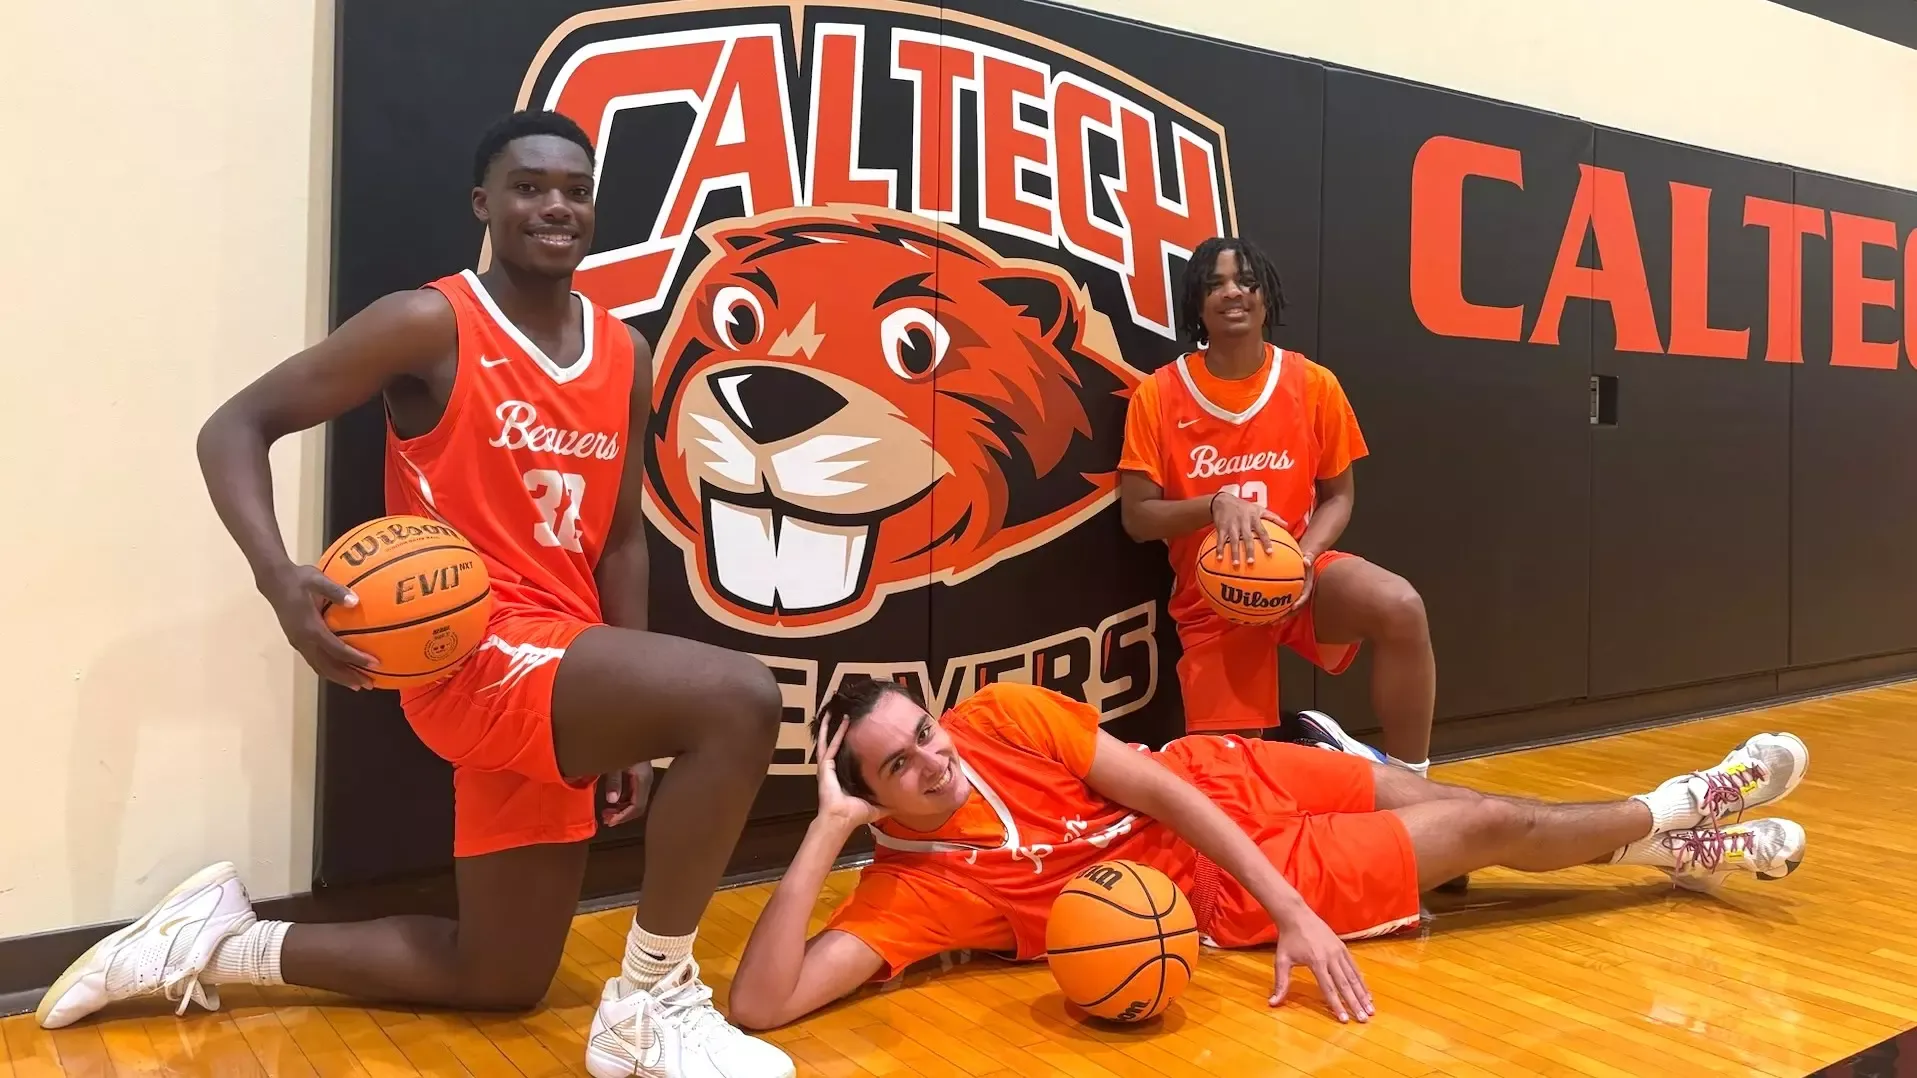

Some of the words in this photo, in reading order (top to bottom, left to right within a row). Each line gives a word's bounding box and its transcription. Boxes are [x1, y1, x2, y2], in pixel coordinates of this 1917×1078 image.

[543, 22, 1227, 341] CALTECH
[488, 399, 620, 460] Beavers
[1187, 444, 1295, 479] Beavers
[339, 523, 462, 567] Wilson
[395, 564, 460, 605] EVO
[1220, 583, 1293, 608] Wilson
